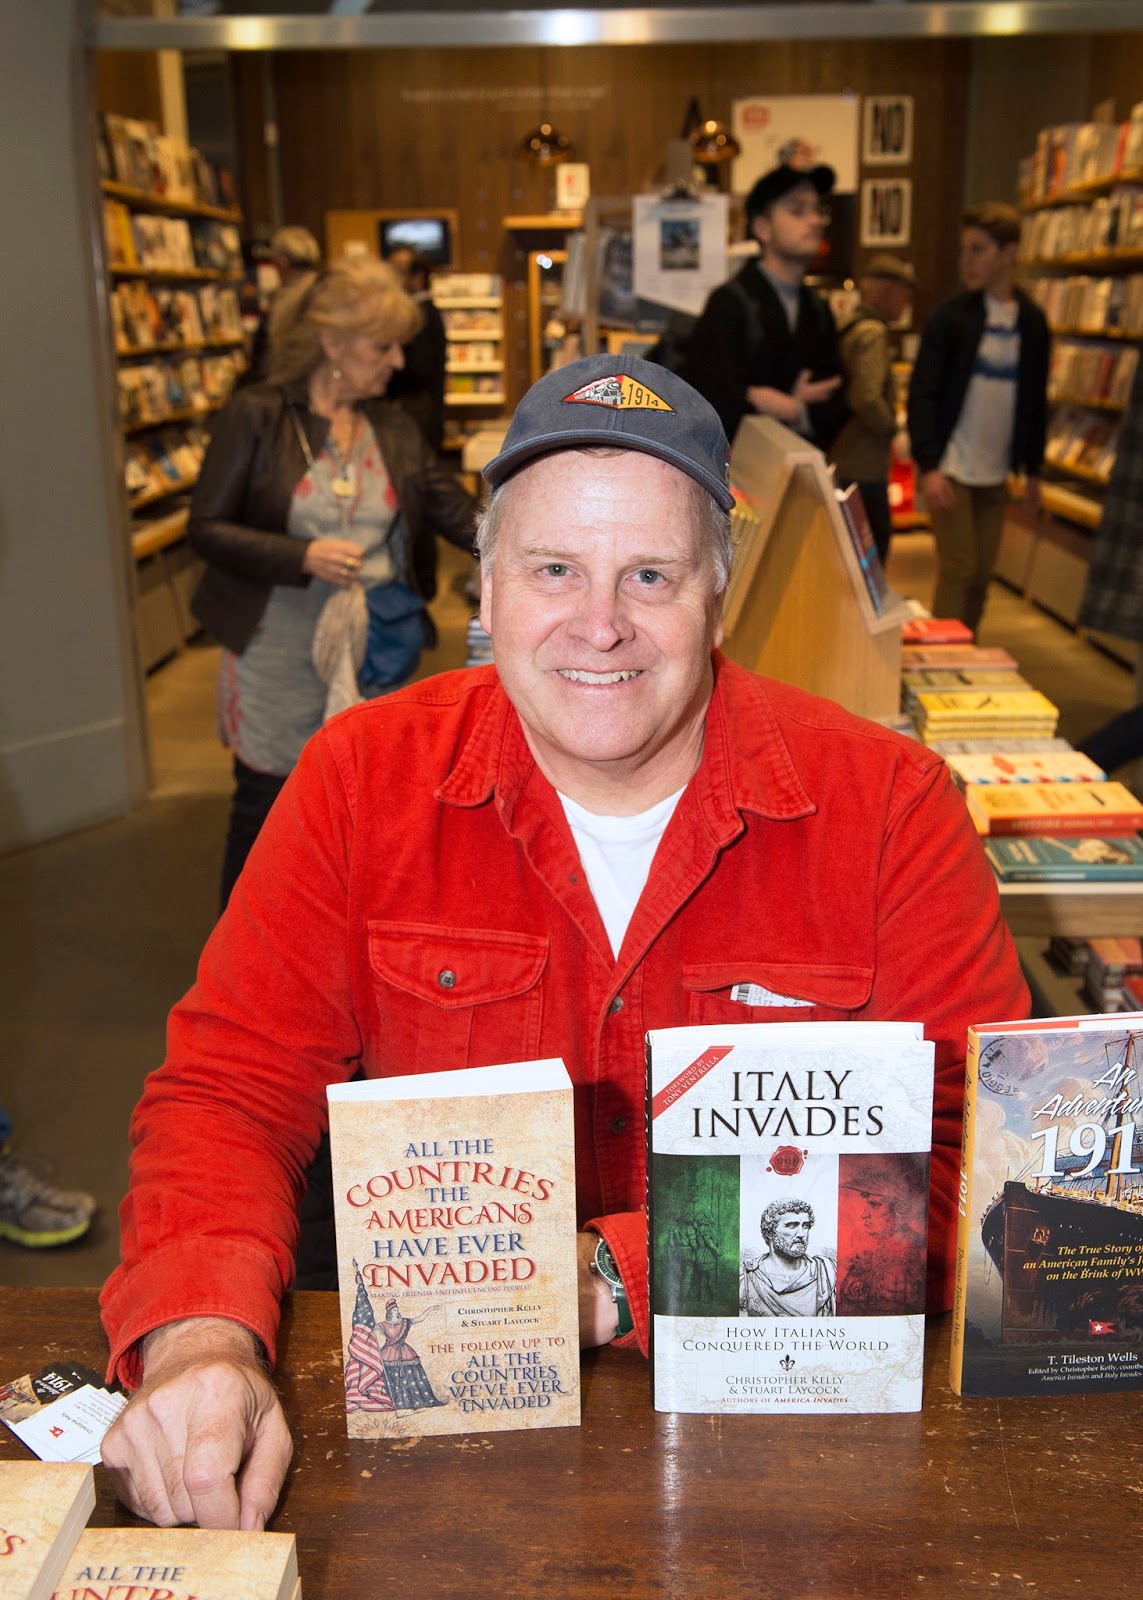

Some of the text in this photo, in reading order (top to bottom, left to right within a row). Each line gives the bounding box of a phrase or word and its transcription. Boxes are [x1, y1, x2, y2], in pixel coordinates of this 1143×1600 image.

[627, 383, 659, 407] 1914
[662, 1055, 720, 1106] TONY VENTRELLA
[665, 1059, 705, 1095] FOREWORD BY
[1092, 1062, 1137, 1090] An
[732, 1069, 853, 1102] ITALY
[692, 1105, 884, 1138] INVADES
[404, 1138, 494, 1158] ALL THE
[1031, 1121, 1141, 1178] 191
[346, 1160, 555, 1208] COUNTRIES
[424, 1186, 470, 1203] THE
[364, 1201, 534, 1234] AMERICANS
[372, 1232, 526, 1259] HAVE EVER
[1057, 1246, 1076, 1256] The
[1078, 1245, 1102, 1255] True
[1103, 1244, 1132, 1255] Story
[1023, 1261, 1036, 1270] an
[1038, 1258, 1088, 1269] American
[1090, 1255, 1135, 1268] Family's
[361, 1257, 537, 1288] INVADED
[1046, 1273, 1059, 1281] on
[1062, 1270, 1078, 1280] the
[1080, 1268, 1109, 1279] Brink
[1111, 1268, 1124, 1280] of
[370, 1291, 400, 1299] MAKING
[402, 1290, 433, 1298] FRIENDS
[434, 1288, 451, 1296] AND
[452, 1286, 502, 1295] INFLUENCING
[457, 1304, 543, 1316] CHRISTOPHER KELLY
[461, 1317, 540, 1328] & STUART LAYCOCK
[726, 1327, 846, 1338] HOW ITALIANS
[427, 1337, 565, 1354] THE FOLLOW UP TO
[682, 1339, 889, 1353] CONQUERED THE WORLD
[466, 1352, 541, 1368] ALL THE
[1047, 1352, 1138, 1365] T. Tileston Wells
[451, 1365, 558, 1384] COUNTRIES
[1050, 1367, 1058, 1375] by
[1060, 1365, 1099, 1374] Christopher
[1100, 1364, 1118, 1373] Kelly,
[1091, 1372, 1104, 1380] and
[1104, 1371, 1119, 1380] Italy
[42, 1372, 74, 1392] 1914
[449, 1379, 567, 1398] WE'VE EVER
[725, 1375, 845, 1385] CHRISTOPHER KELLY
[729, 1385, 840, 1395] & STUART LAYCOCK
[459, 1395, 551, 1412] INVADED
[76, 1566, 186, 1582] ALL THE
